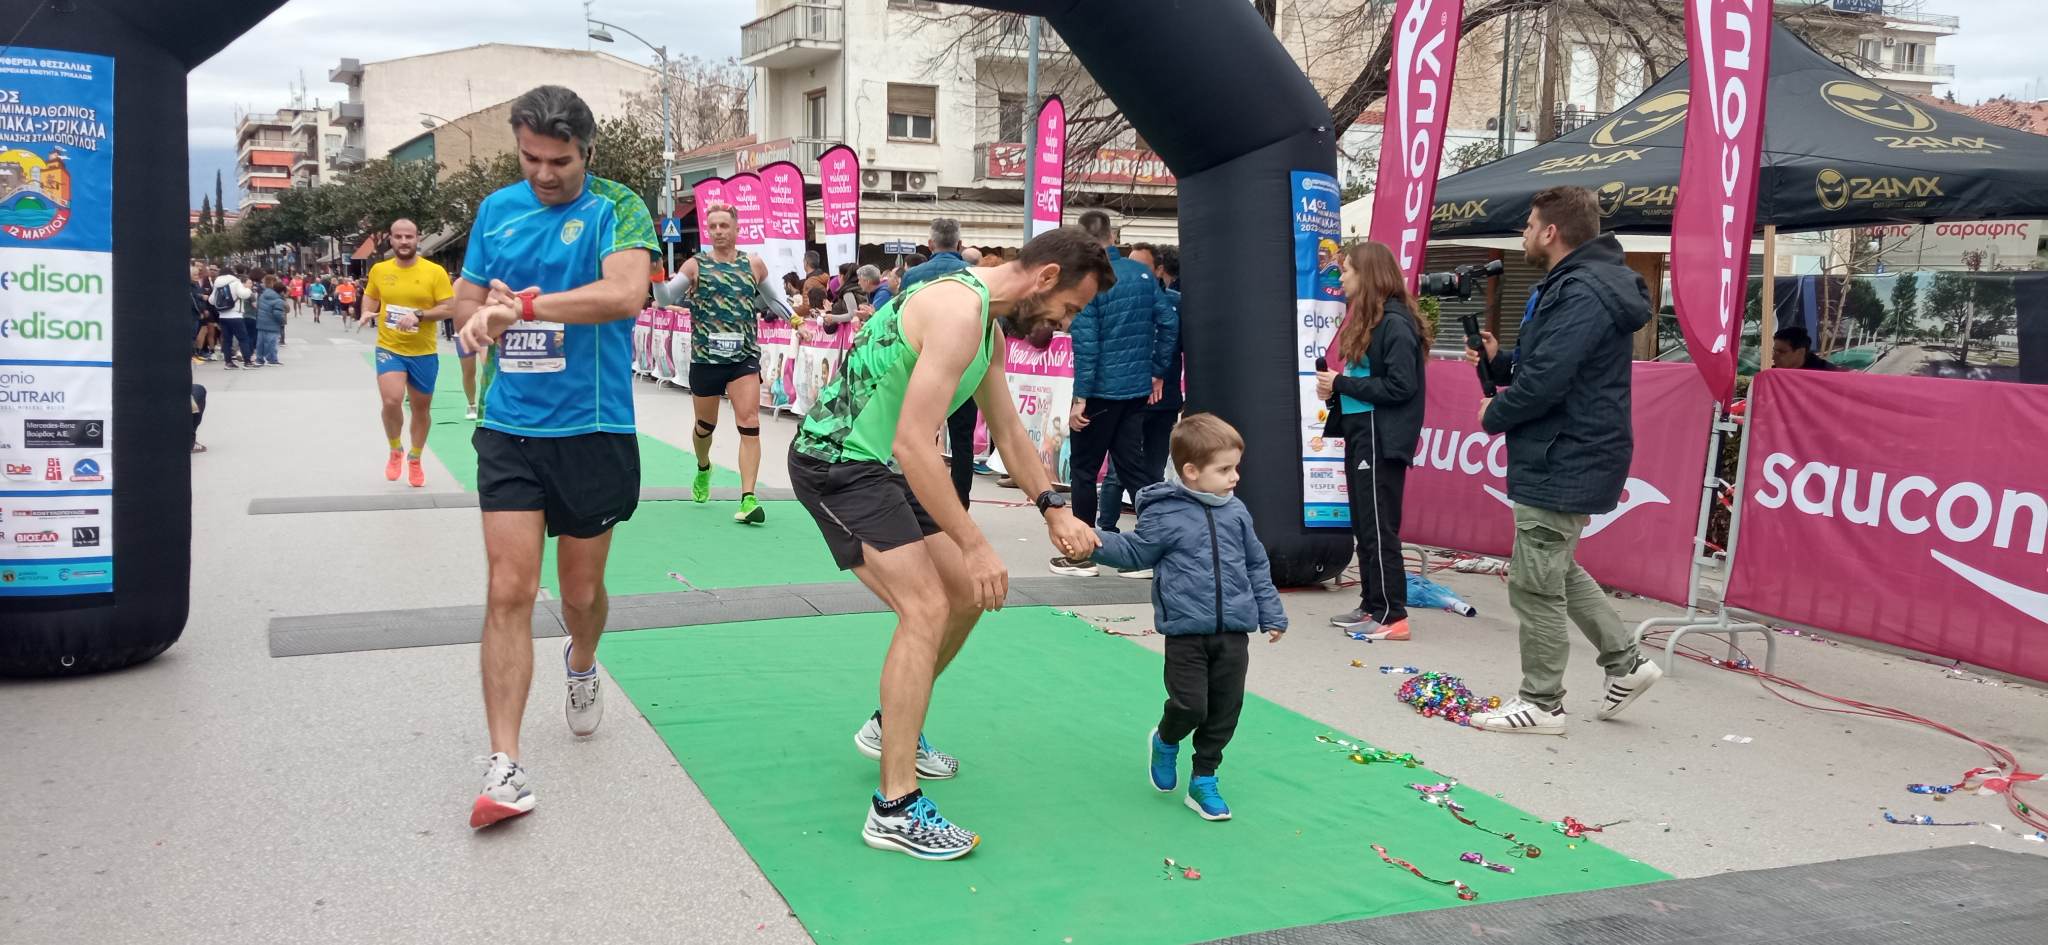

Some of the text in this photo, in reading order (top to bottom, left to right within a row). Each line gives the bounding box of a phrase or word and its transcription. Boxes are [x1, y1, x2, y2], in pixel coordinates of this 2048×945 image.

[40, 60, 92, 73] ΘΕΣΣΑΛΙΑΣ
[0, 104, 96, 121] ΜΙΜΑΡΑΘΩΝΙΟΣ
[32, 134, 97, 151] ΣΤΑΜΟΠΟΥΛΟΣ
[1850, 176, 1944, 199] 24MX
[1431, 198, 1489, 221] 4MX
[22, 214, 67, 239] ΜΑΡΤΙΟΥ
[1, 264, 103, 294] edison
[1, 312, 103, 341] edison
[505, 332, 547, 350] 22742
[1019, 394, 1036, 415] 75
[1412, 427, 1508, 478] auco
[6, 464, 32, 473] Dole
[1754, 452, 2048, 555] saucon
